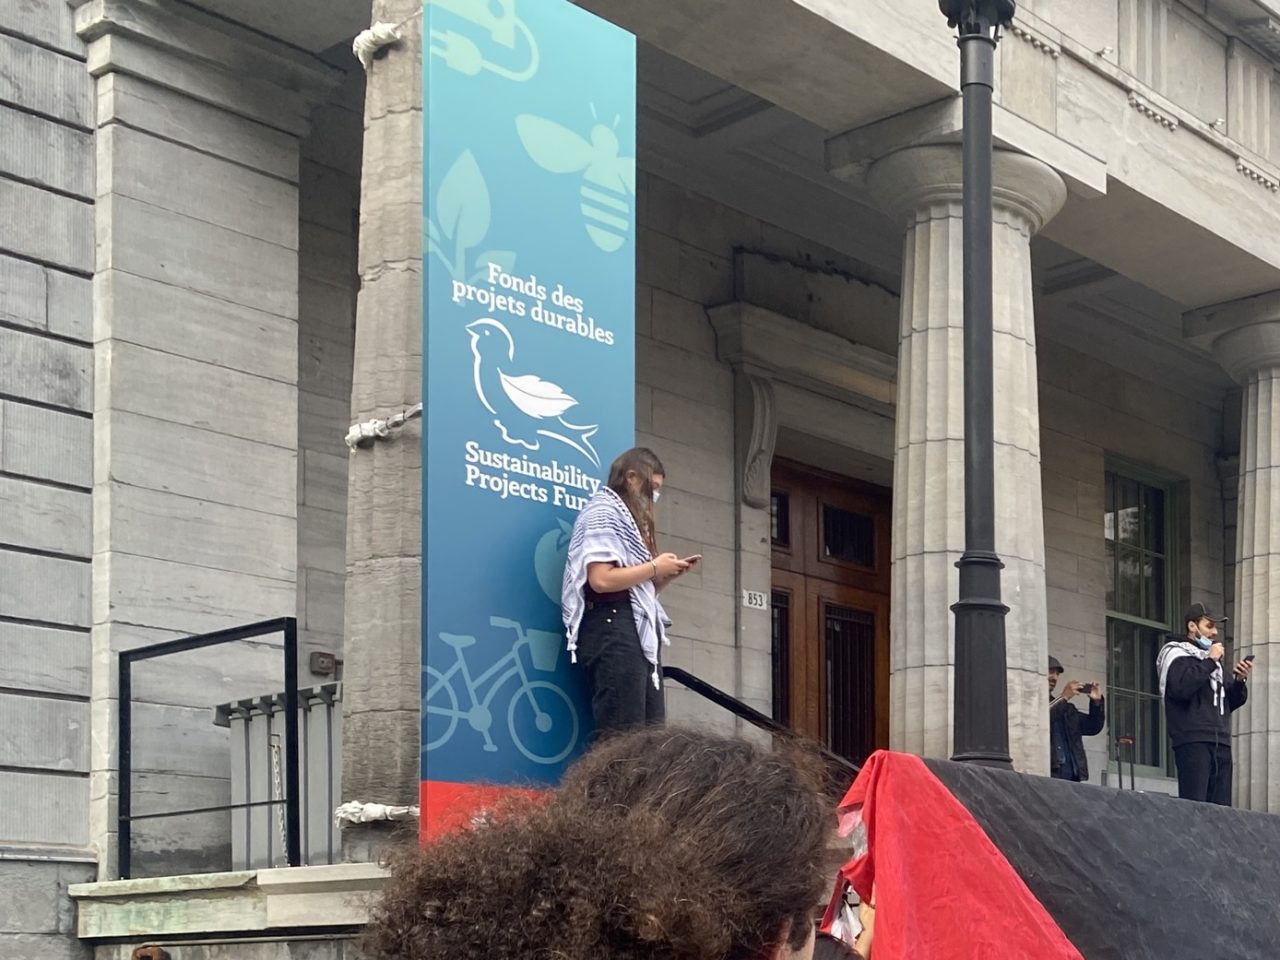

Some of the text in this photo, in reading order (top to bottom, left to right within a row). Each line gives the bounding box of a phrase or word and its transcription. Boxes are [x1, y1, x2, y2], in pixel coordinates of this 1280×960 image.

[452, 279, 615, 345] projets durables
[487, 261, 584, 313] Fonds des
[465, 440, 602, 498] Sustainability
[465, 463, 589, 511] Projects Fun
[747, 592, 764, 607] 853
